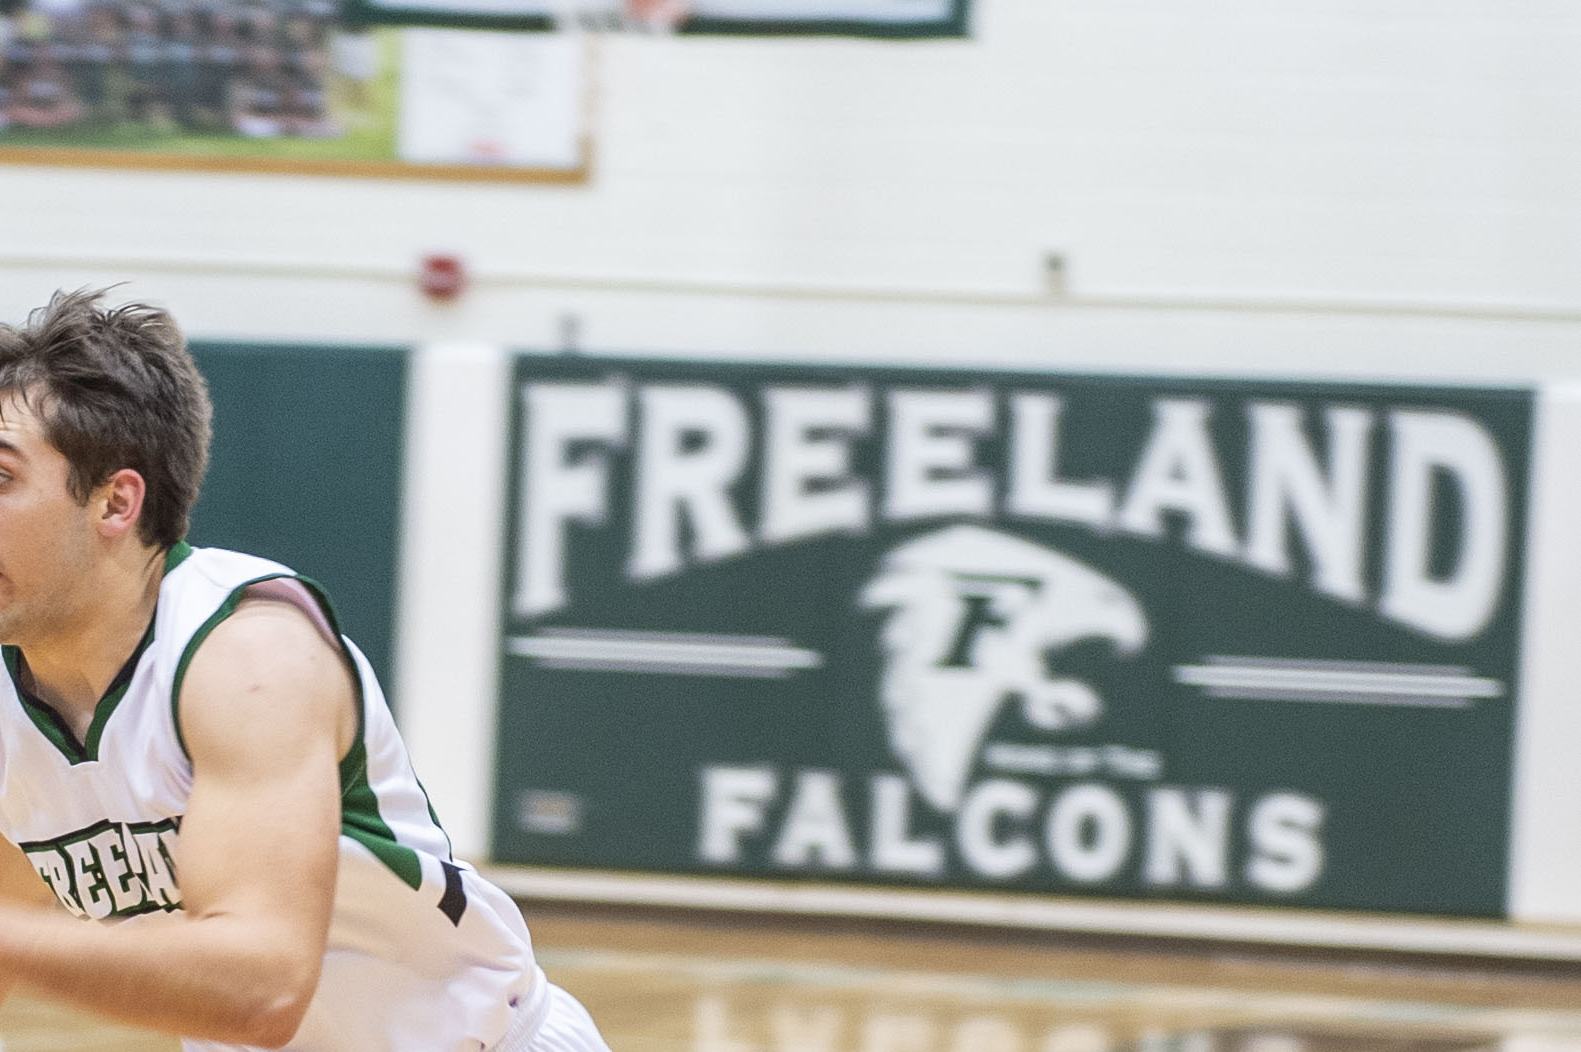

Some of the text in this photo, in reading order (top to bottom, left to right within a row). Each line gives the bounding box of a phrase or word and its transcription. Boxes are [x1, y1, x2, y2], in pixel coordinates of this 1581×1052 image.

[513, 379, 1509, 644] FREELAND
[934, 572, 1044, 669] F
[697, 765, 1326, 894] FALCONS
